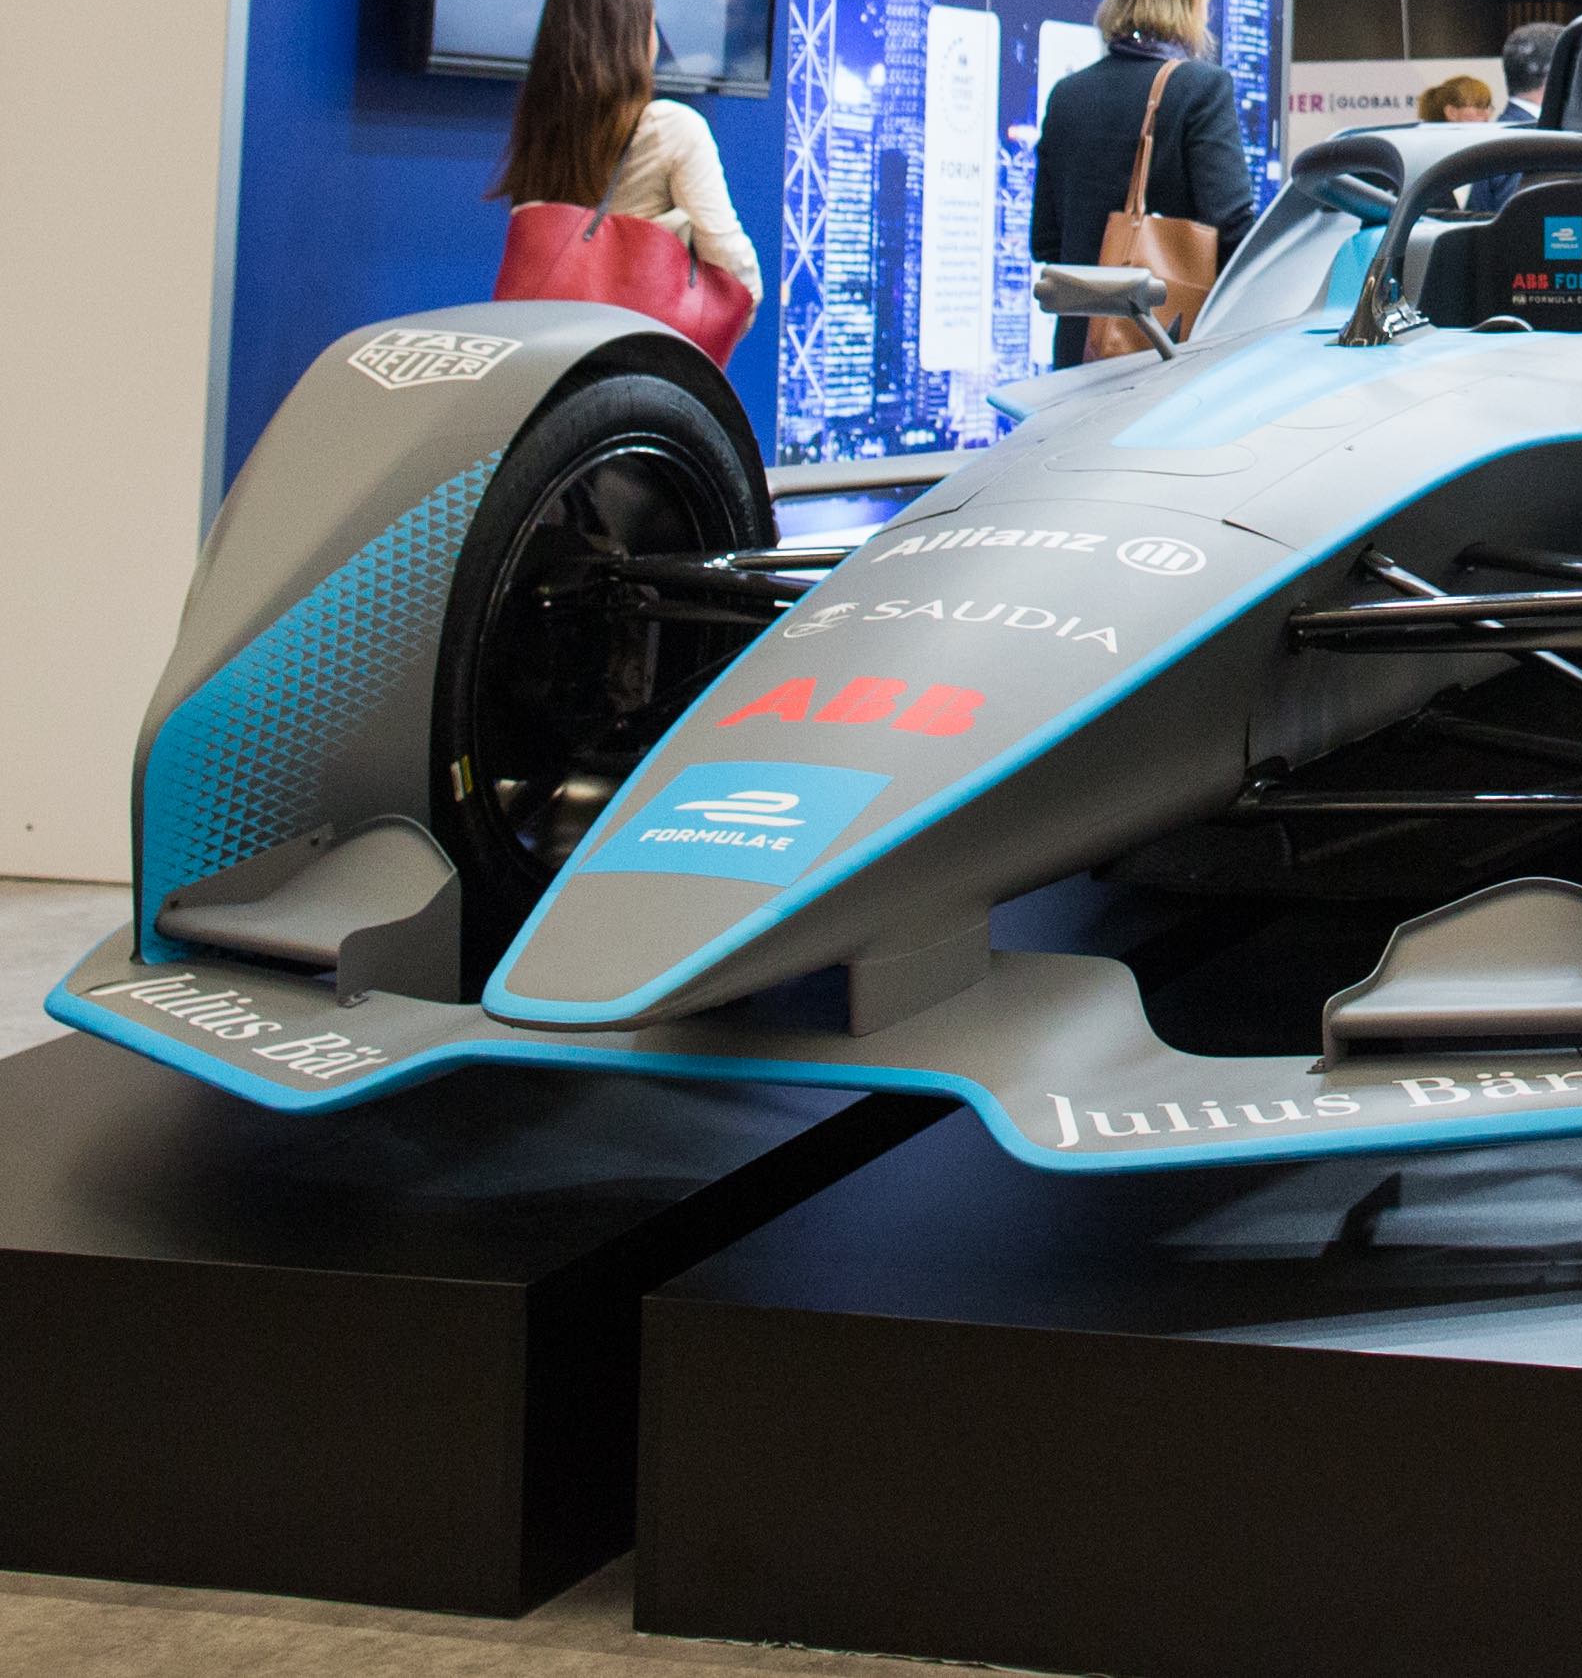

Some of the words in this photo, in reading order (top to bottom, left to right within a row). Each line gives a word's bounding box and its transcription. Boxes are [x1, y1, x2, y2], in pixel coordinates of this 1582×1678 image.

[1337, 94, 1399, 110] GLOBAL
[1512, 273, 1549, 290] ABB
[1529, 295, 1573, 304] FORMULA
[393, 333, 503, 356] TAG
[360, 347, 482, 382] HEUER
[873, 525, 1108, 564] Allianz
[863, 598, 1119, 654] SAUDIA
[715, 676, 986, 737] ABB
[89, 972, 284, 1041] Julius
[252, 1031, 389, 1080] Bär
[1045, 1091, 1362, 1148] Julius
